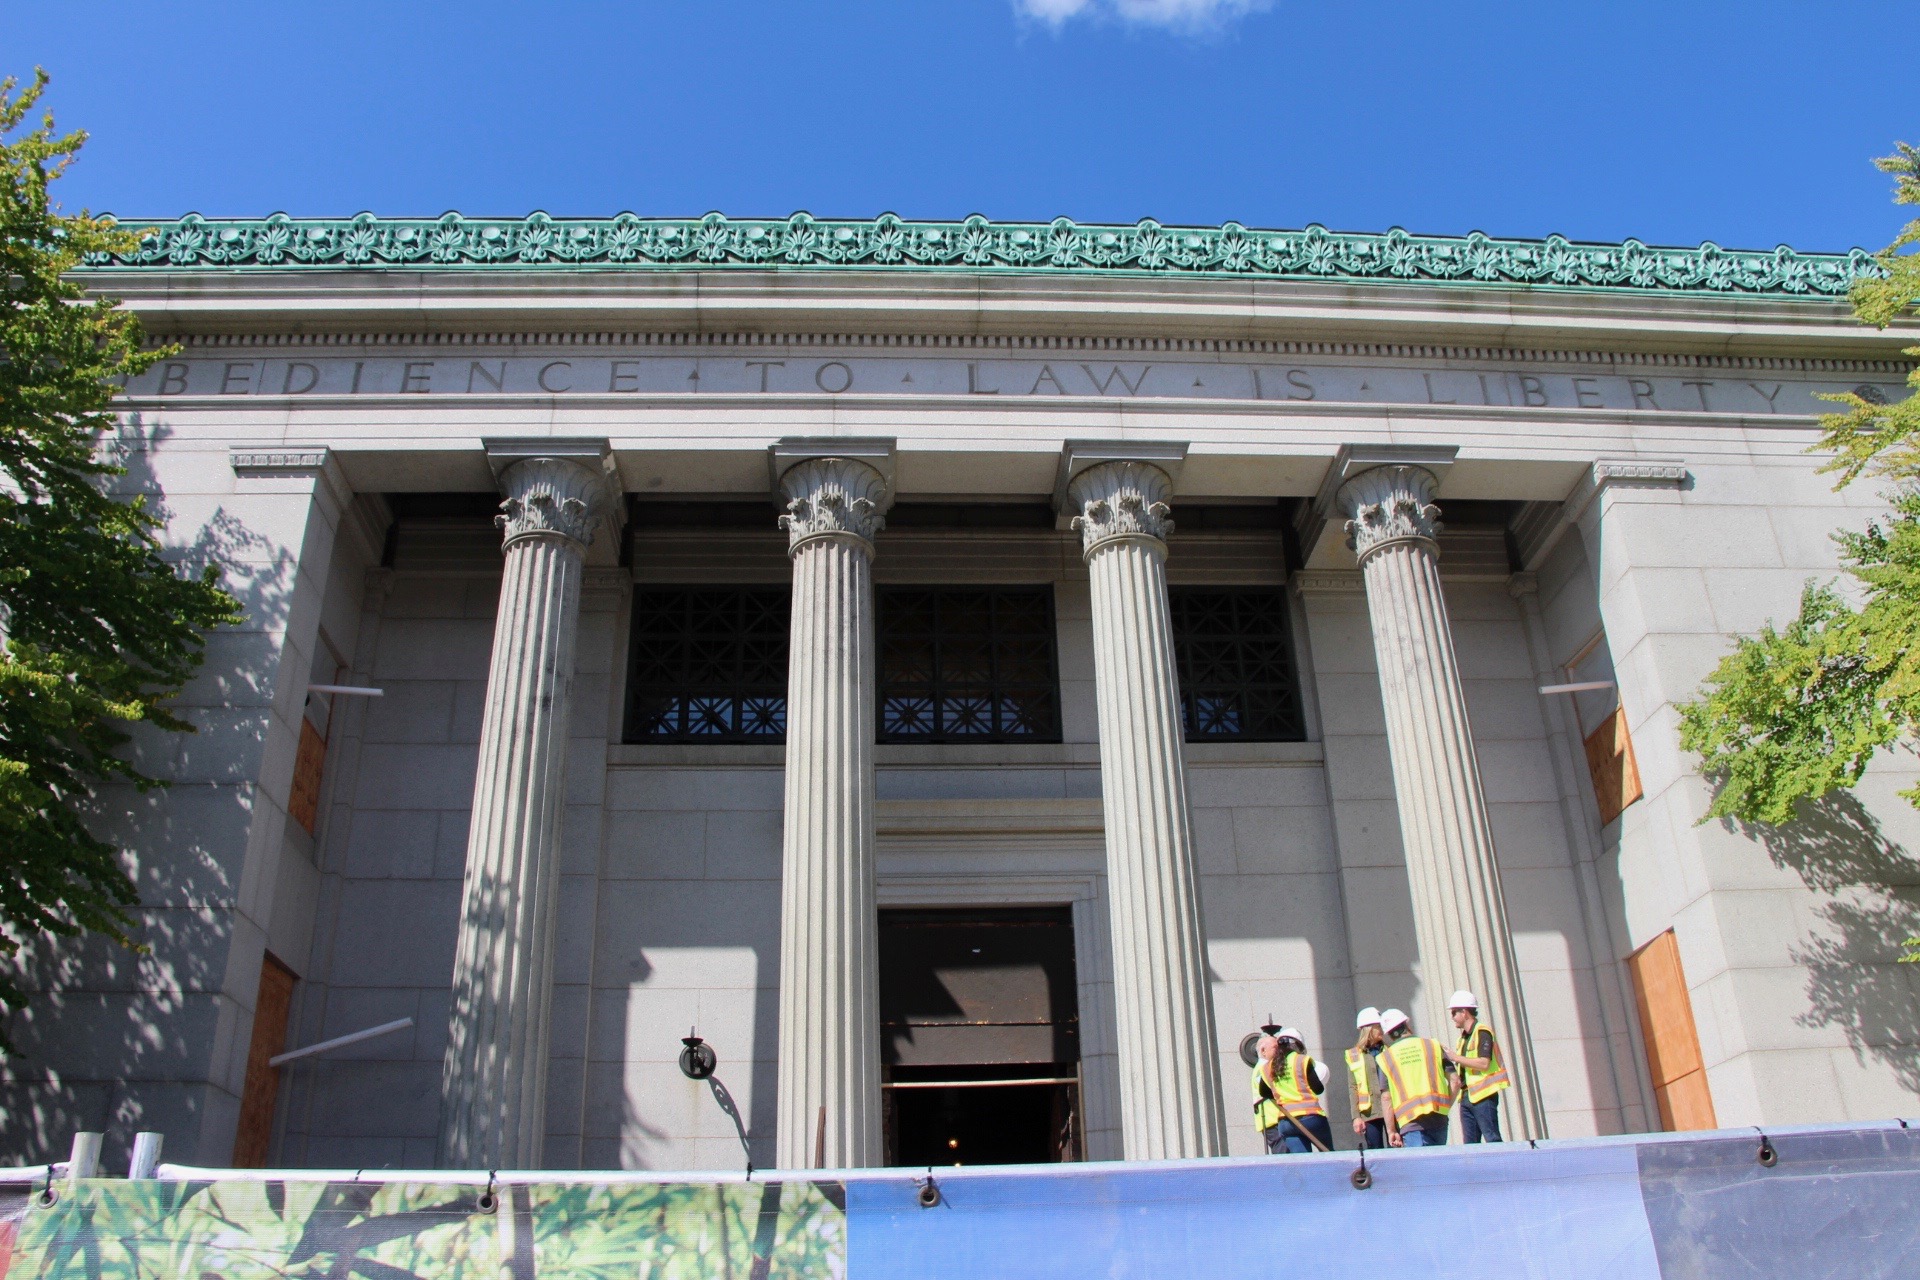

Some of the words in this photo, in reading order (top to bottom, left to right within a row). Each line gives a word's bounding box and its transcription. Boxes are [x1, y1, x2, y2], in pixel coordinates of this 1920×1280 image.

[117, 360, 640, 395] BEDIENCE
[745, 360, 854, 393] TO
[966, 363, 1151, 396] LAW
[1252, 368, 1316, 401] IS
[1422, 373, 1783, 414] LIBERTY
